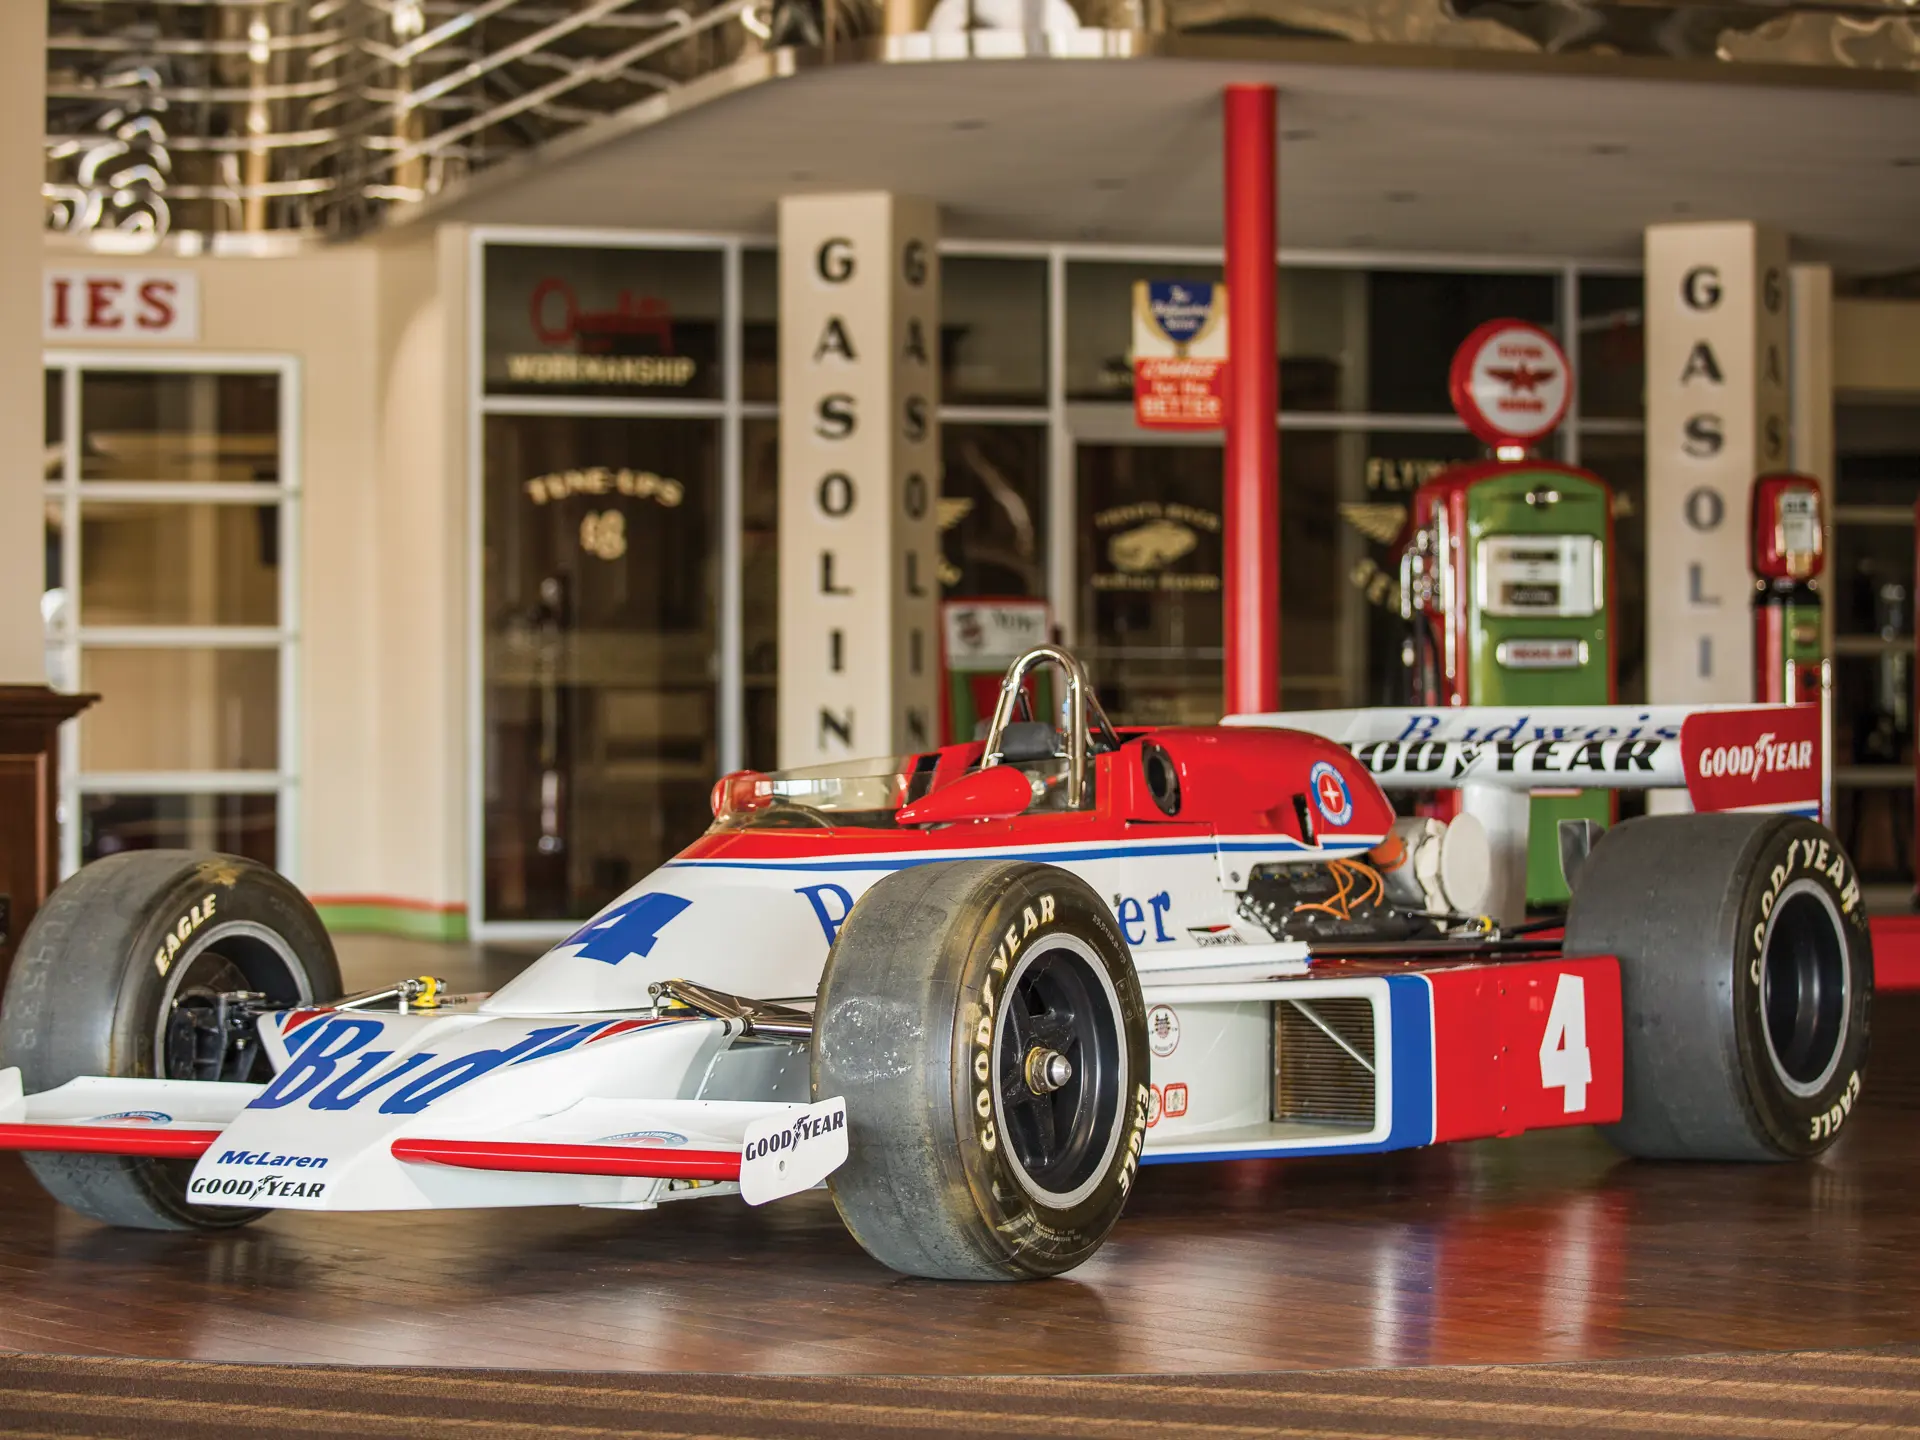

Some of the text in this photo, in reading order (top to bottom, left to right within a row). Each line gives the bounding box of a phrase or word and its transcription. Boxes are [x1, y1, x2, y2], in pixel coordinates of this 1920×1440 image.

[1699, 735, 1813, 780] GOODYEAR
[154, 893, 217, 977] EAGLE
[550, 892, 693, 966] 4
[245, 1018, 581, 1116] Bud
[1539, 972, 1592, 1113] 4
[745, 1110, 844, 1162] GOODYEAR
[1118, 1082, 1150, 1198] EAGLE
[1810, 1070, 1863, 1141] EAGLE
[190, 1175, 326, 1200] GOODYEAR
[216, 1150, 329, 1170] McLaren
